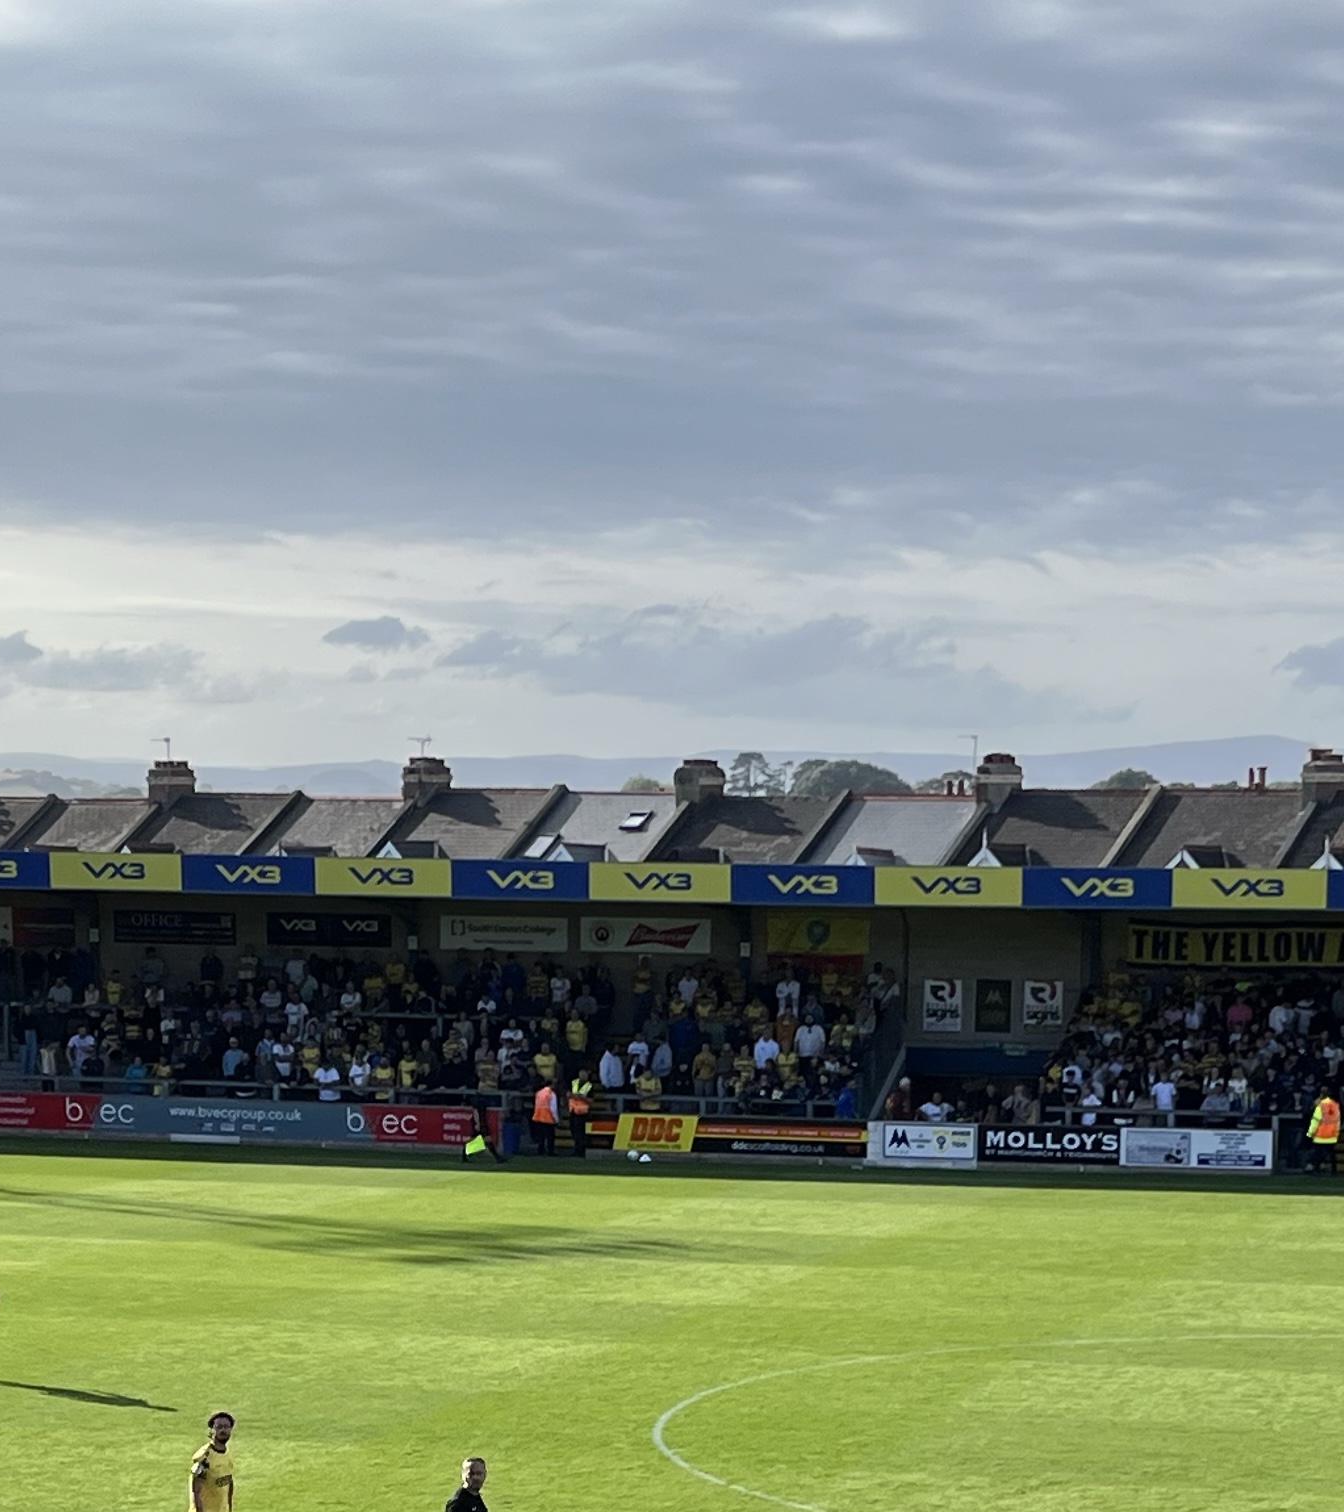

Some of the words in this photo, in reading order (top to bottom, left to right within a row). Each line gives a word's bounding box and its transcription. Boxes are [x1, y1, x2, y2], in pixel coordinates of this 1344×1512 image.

[82, 859, 147, 880] VX3
[216, 863, 282, 884] VX3
[348, 865, 415, 886] VX3
[487, 868, 555, 890] VX3
[624, 870, 693, 892] VX3
[767, 873, 839, 895] VX3
[911, 874, 983, 896] VX3
[1061, 876, 1135, 898] VX3
[1211, 876, 1286, 898] VX3
[130, 912, 183, 928] OFFICE
[1132, 929, 1189, 961] THE
[1202, 930, 1326, 963] YELLOW
[169, 1105, 302, 1125] www.bvecgroup.co.uk
[630, 1116, 684, 1142] DDC
[985, 1129, 1119, 1152] MOLLOY'S
